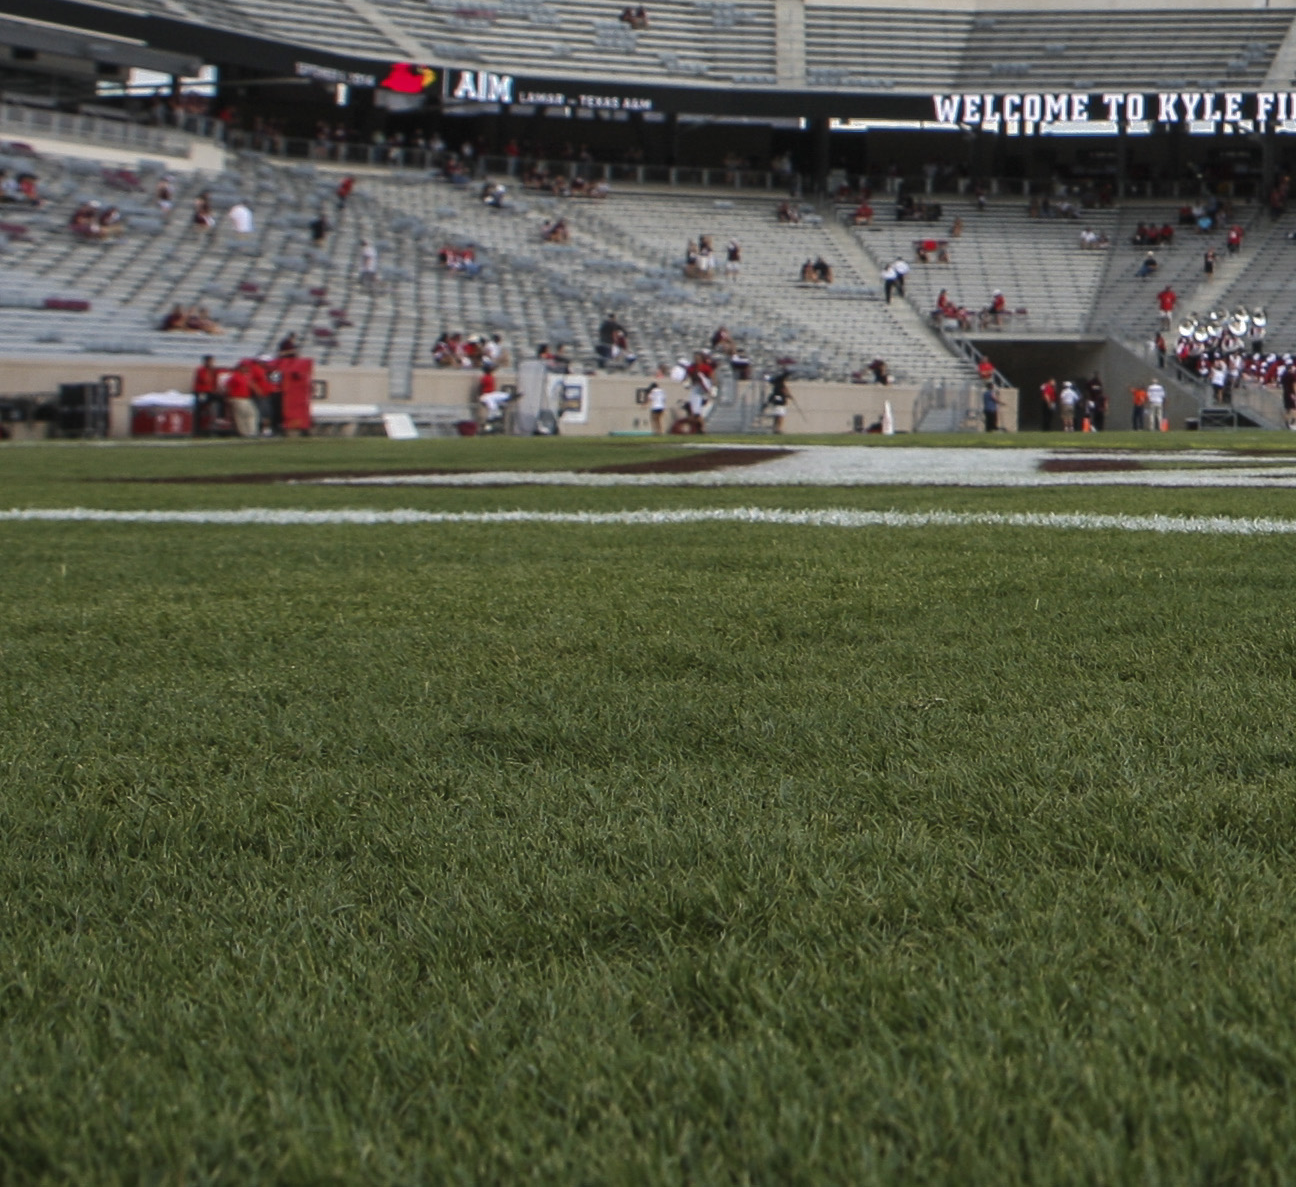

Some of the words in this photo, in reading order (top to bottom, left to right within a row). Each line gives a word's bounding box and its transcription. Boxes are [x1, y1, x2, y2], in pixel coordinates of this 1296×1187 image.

[932, 93, 1090, 123] WELCOME
[1103, 93, 1145, 122] TO
[1157, 92, 1243, 122] KYLE
